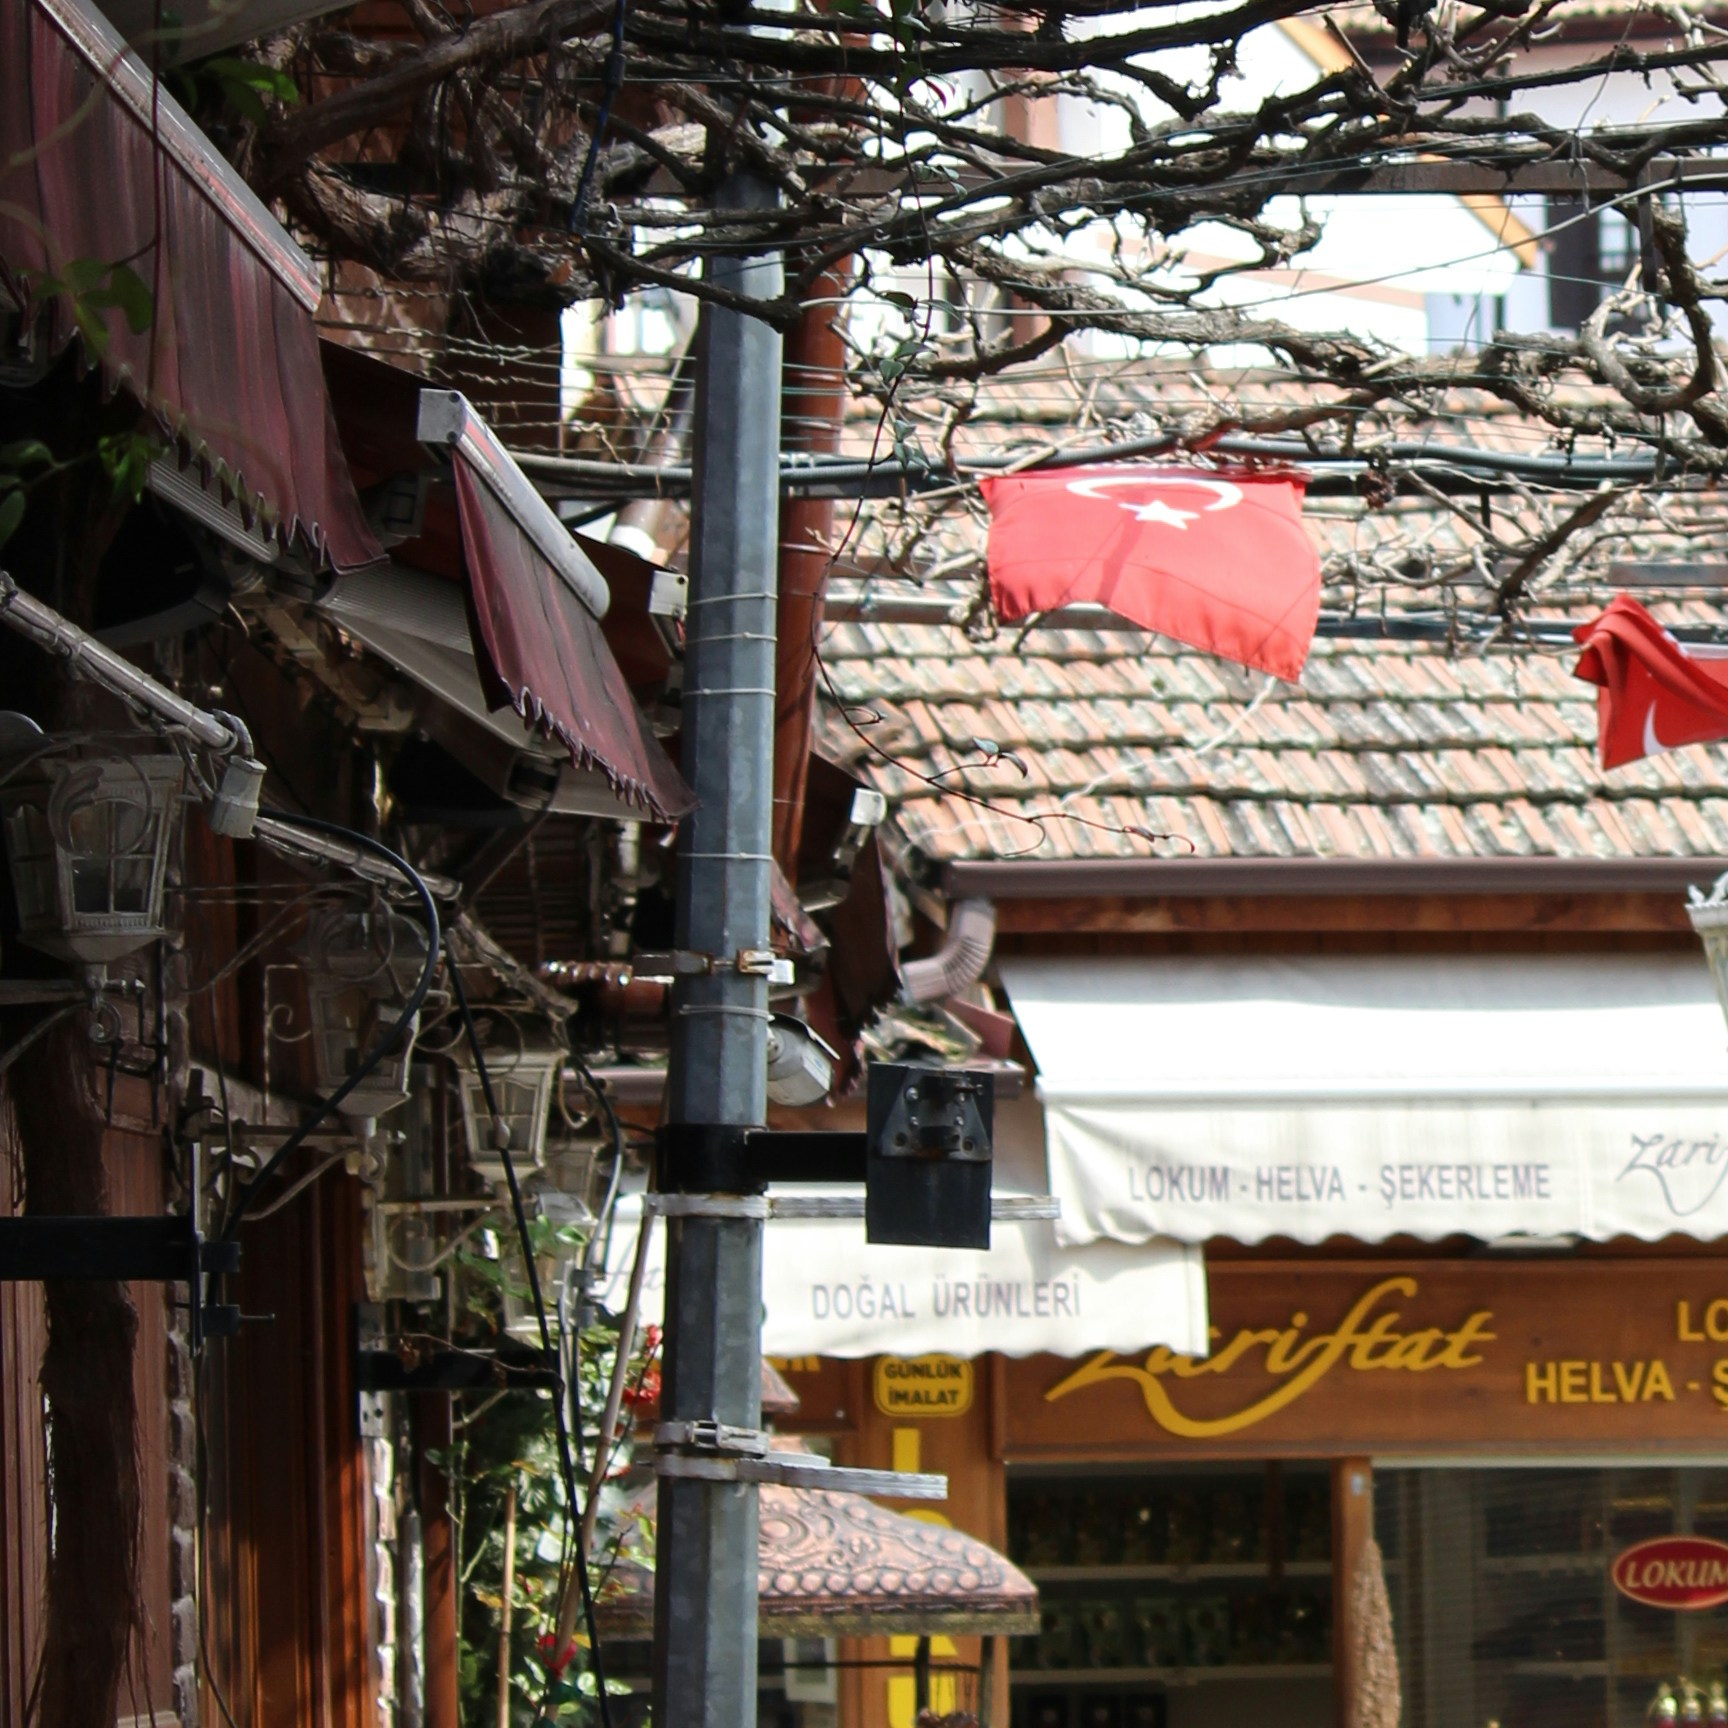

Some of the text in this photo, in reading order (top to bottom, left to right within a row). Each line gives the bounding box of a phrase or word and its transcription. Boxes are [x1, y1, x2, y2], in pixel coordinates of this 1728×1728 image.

[1129, 1165, 1231, 1203] LOKUM
[1256, 1166, 1347, 1202] HELVA
[1379, 1163, 1553, 1212] ŞEKERLEME
[811, 1273, 1082, 1320] DOĞAL ÜRÜNLERİ
[1526, 1360, 1675, 1404] HELVA
